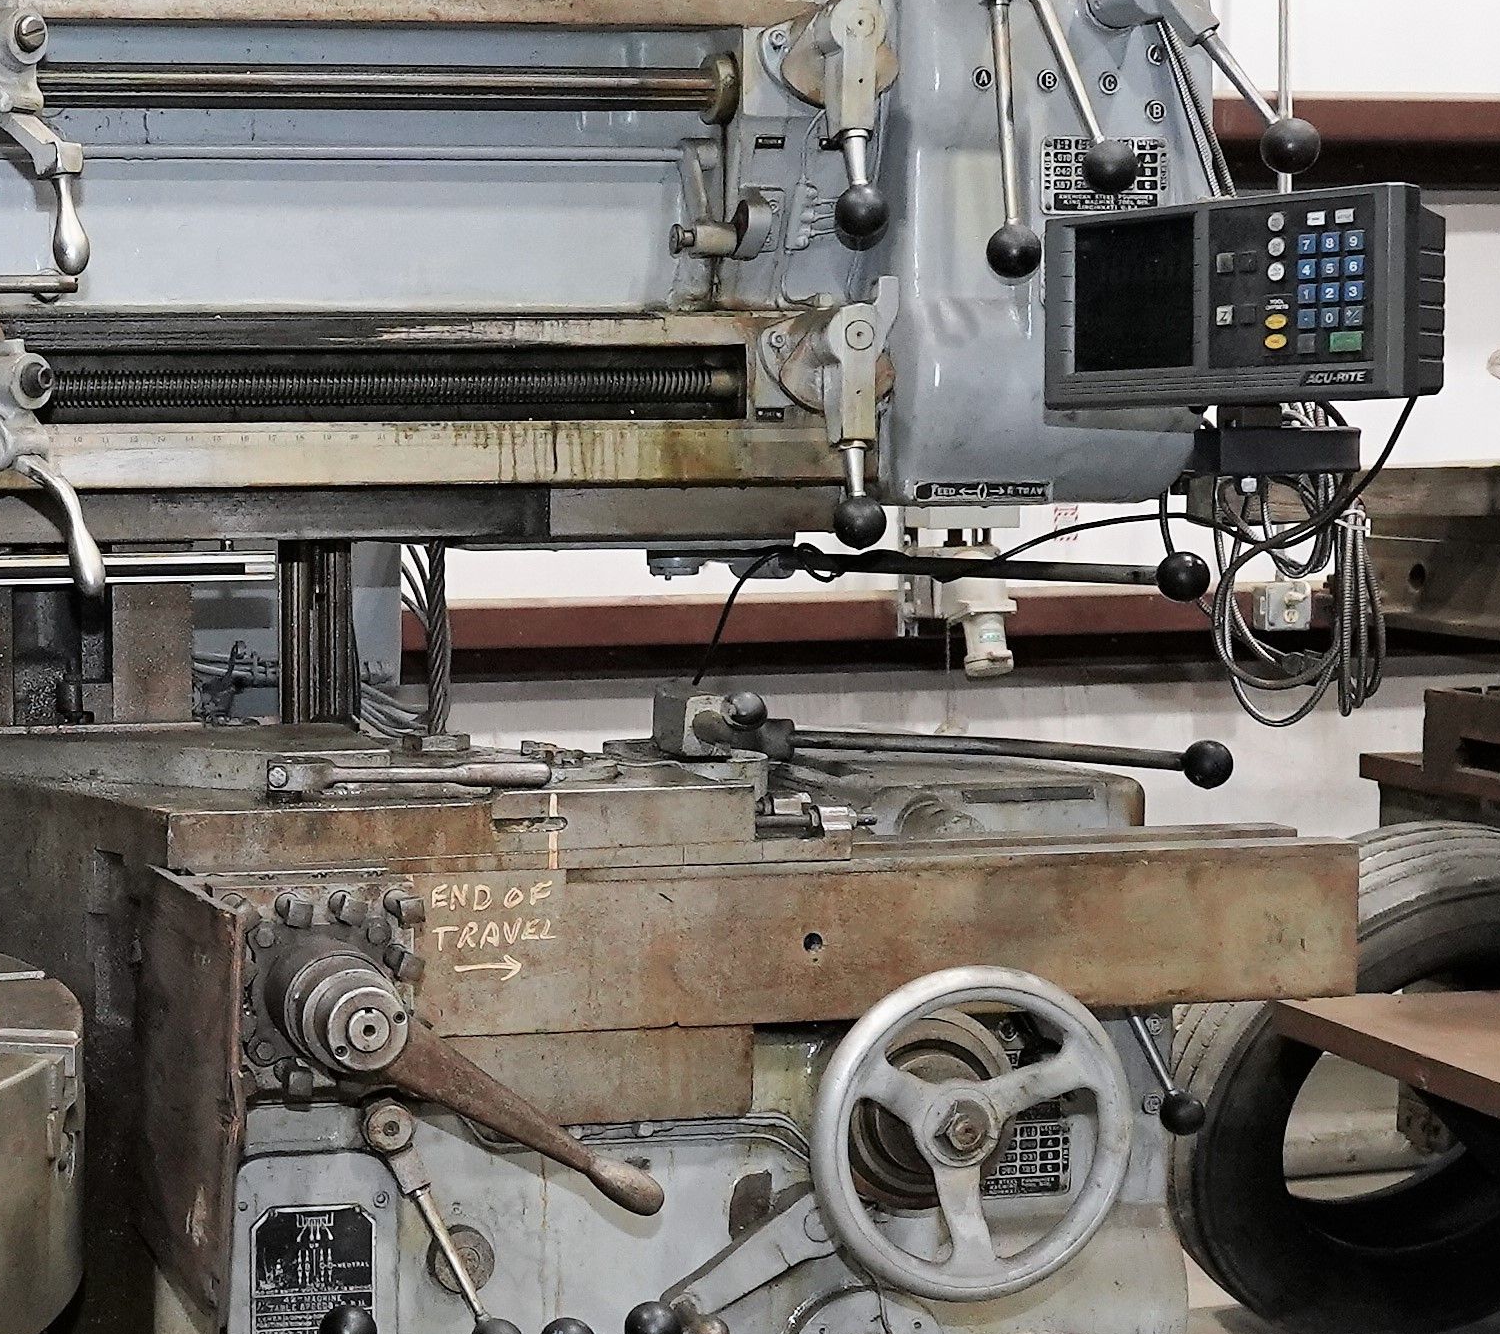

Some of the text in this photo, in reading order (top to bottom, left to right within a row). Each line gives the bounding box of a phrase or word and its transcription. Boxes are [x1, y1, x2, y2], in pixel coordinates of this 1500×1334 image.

[979, 72, 1115, 90] A B C
[1153, 104, 1162, 117] B
[1302, 235, 1359, 251] 7 8 9
[1302, 261, 1359, 276] 4 5 6
[1325, 287, 1335, 299] 2
[1349, 285, 1358, 297] 3
[1220, 310, 1229, 323] Z
[1325, 312, 1334, 324] 0
[1306, 370, 1367, 384] ACU-RITE
[431, 880, 553, 911] END OF
[431, 917, 556, 952] TRAVEL
